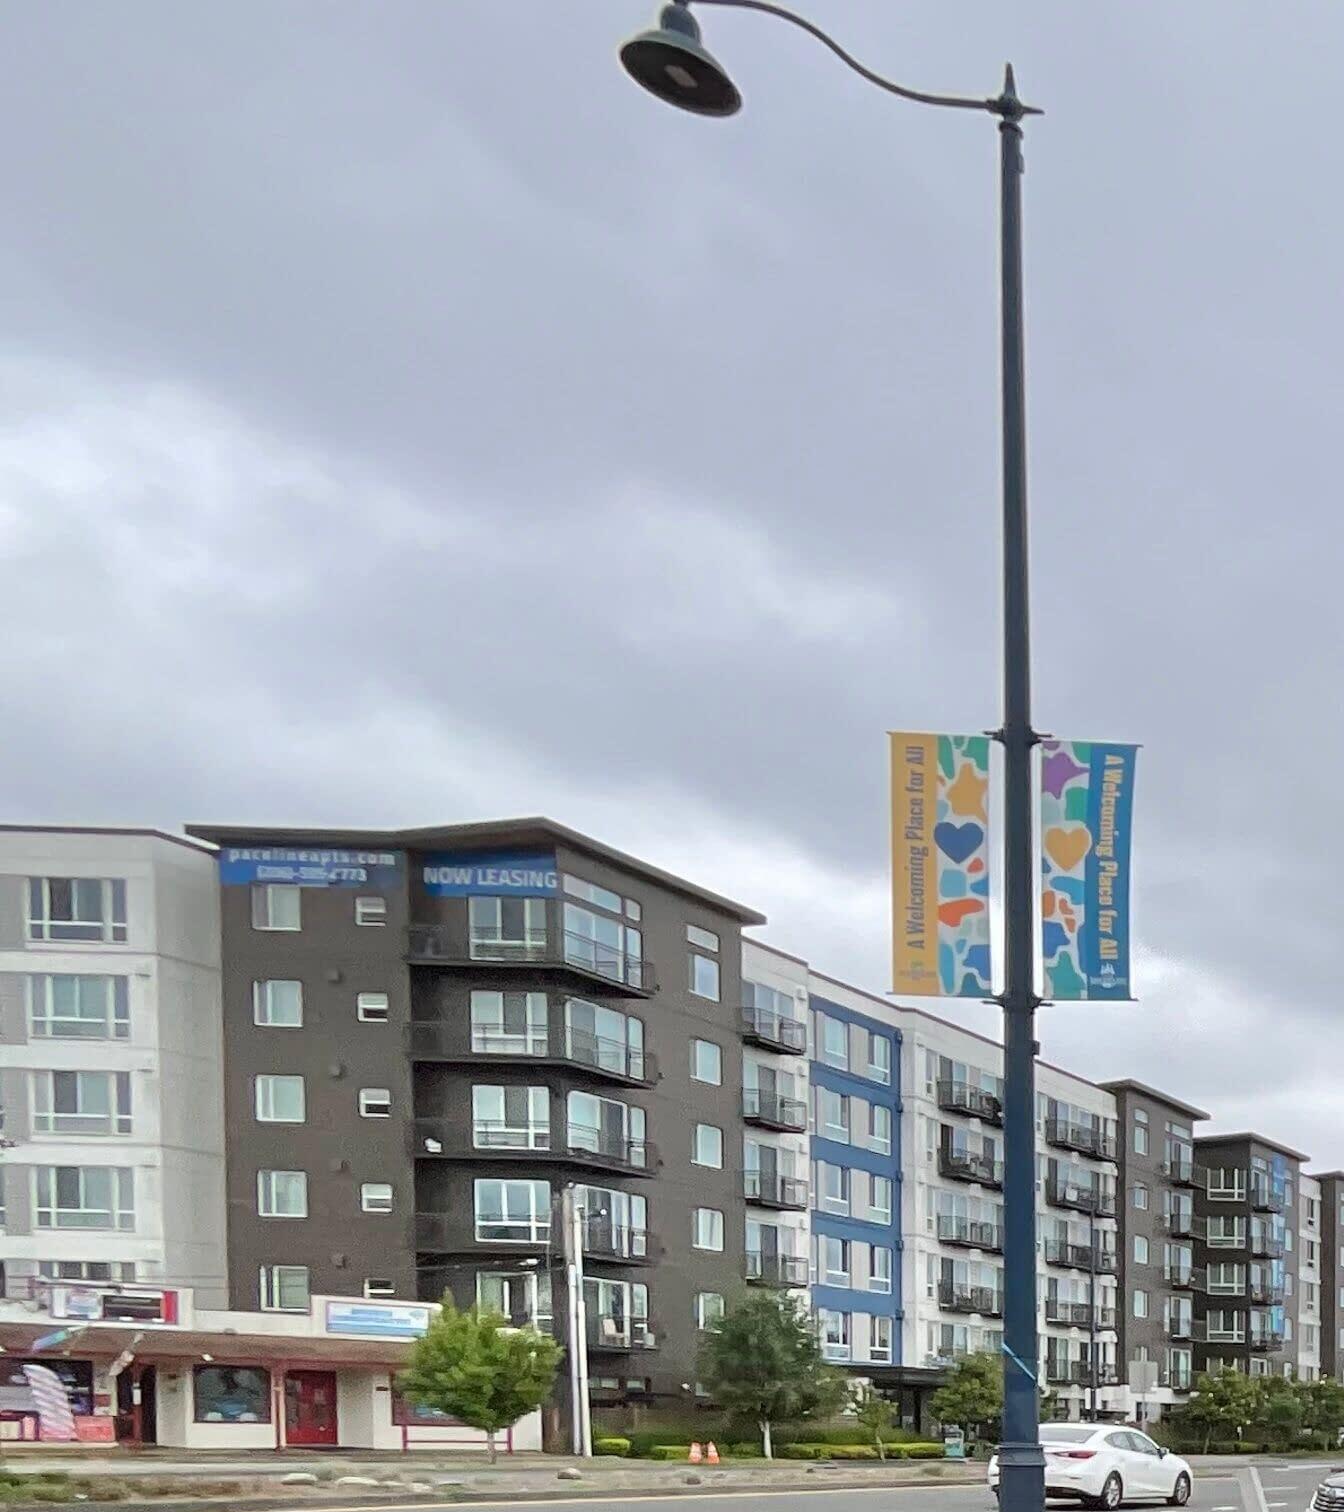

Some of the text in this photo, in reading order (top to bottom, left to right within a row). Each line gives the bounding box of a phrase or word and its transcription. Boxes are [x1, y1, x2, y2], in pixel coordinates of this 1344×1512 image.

[906, 746, 924, 765] All
[1105, 754, 1124, 766] A
[905, 771, 924, 793] for
[905, 799, 924, 841] Place
[1095, 768, 1123, 858] Welcoming
[423, 866, 557, 889] NOW LEASING
[1098, 861, 1118, 905] Place
[905, 846, 928, 934] Welcoming
[1098, 910, 1118, 934] for
[907, 937, 925, 950] A
[1099, 938, 1119, 960] All
